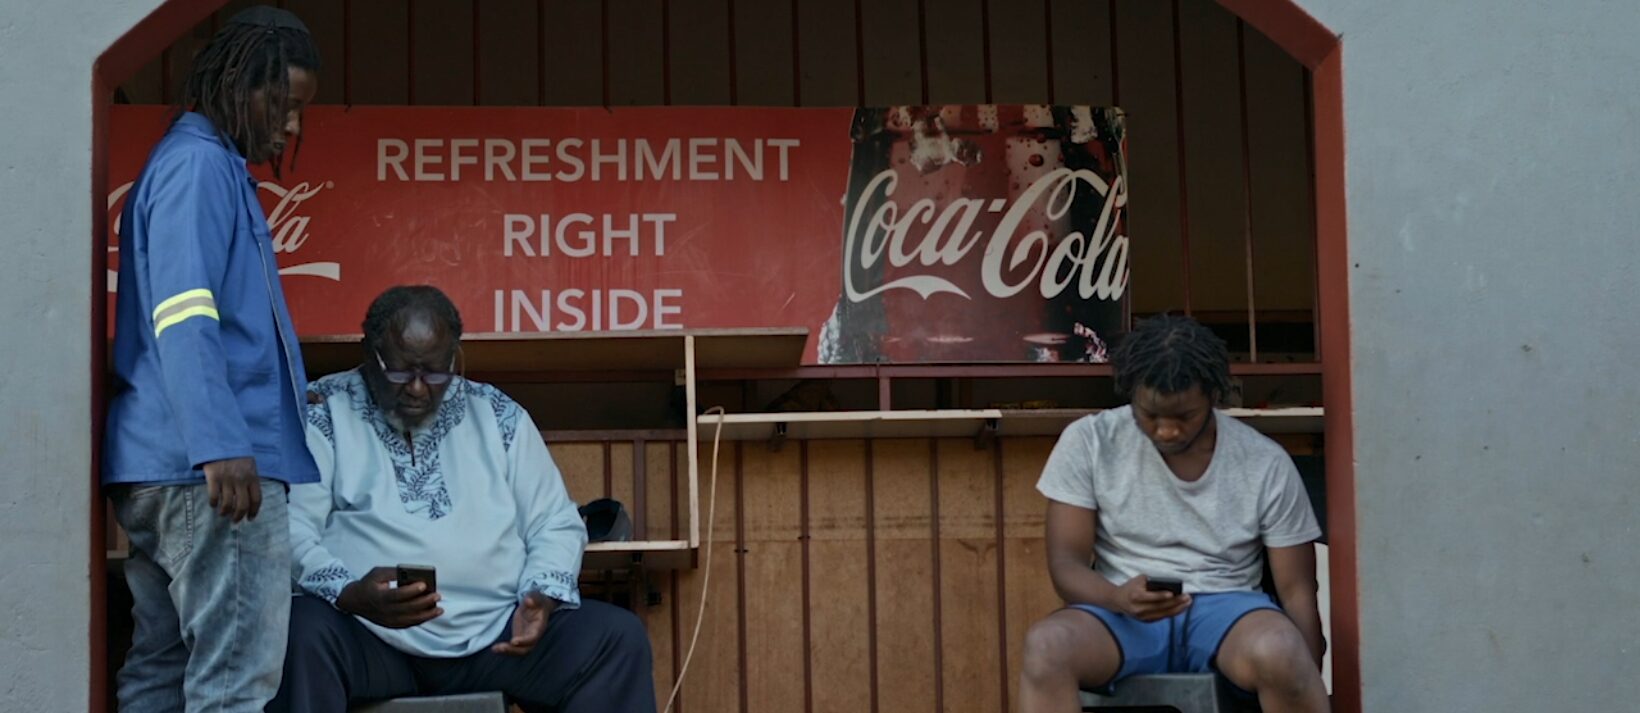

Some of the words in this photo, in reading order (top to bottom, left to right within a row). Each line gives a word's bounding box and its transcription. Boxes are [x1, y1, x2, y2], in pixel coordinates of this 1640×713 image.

[376, 138, 800, 182] REFRESHMENT
[503, 213, 677, 257] RIGHT
[845, 168, 1129, 302] Coca-Cola
[494, 289, 684, 332] INSIDE
